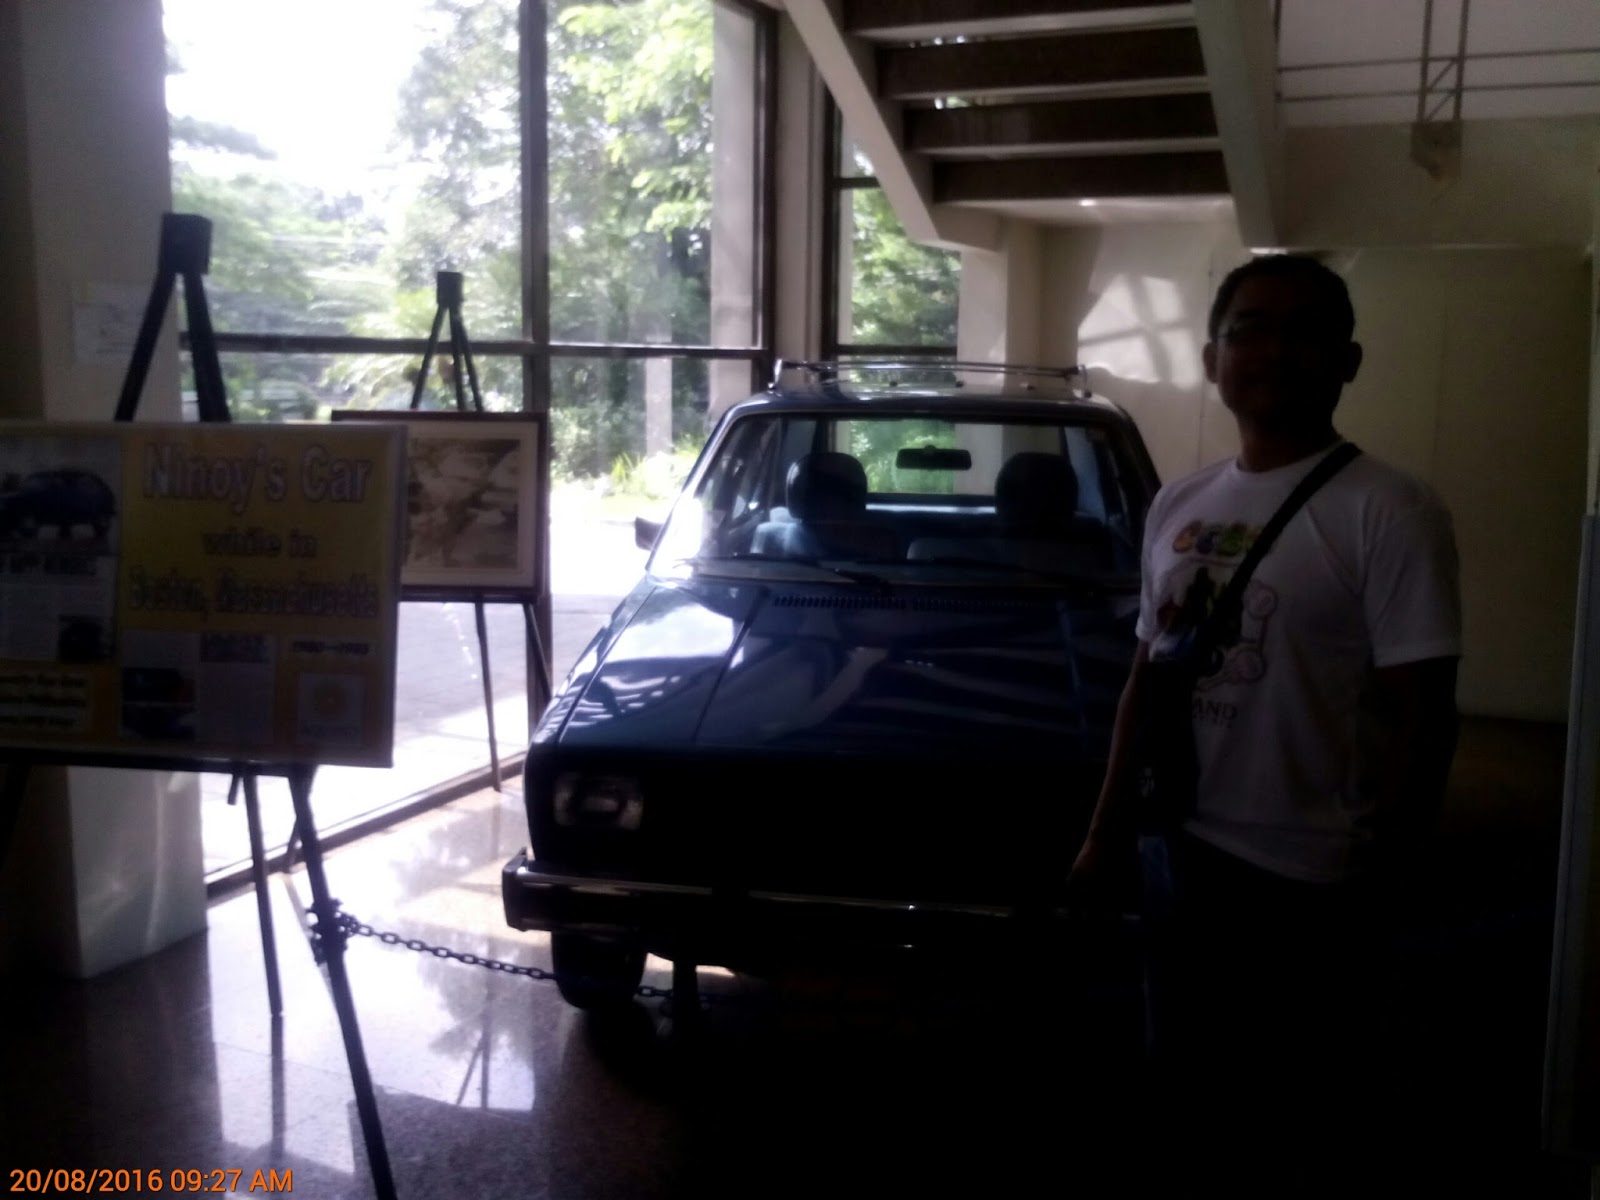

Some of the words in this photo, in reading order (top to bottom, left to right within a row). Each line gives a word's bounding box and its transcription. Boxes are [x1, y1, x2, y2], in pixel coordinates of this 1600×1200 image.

[143, 443, 288, 514] Ninoy's
[301, 443, 375, 503] Car
[203, 526, 282, 557] while
[289, 528, 318, 558] in
